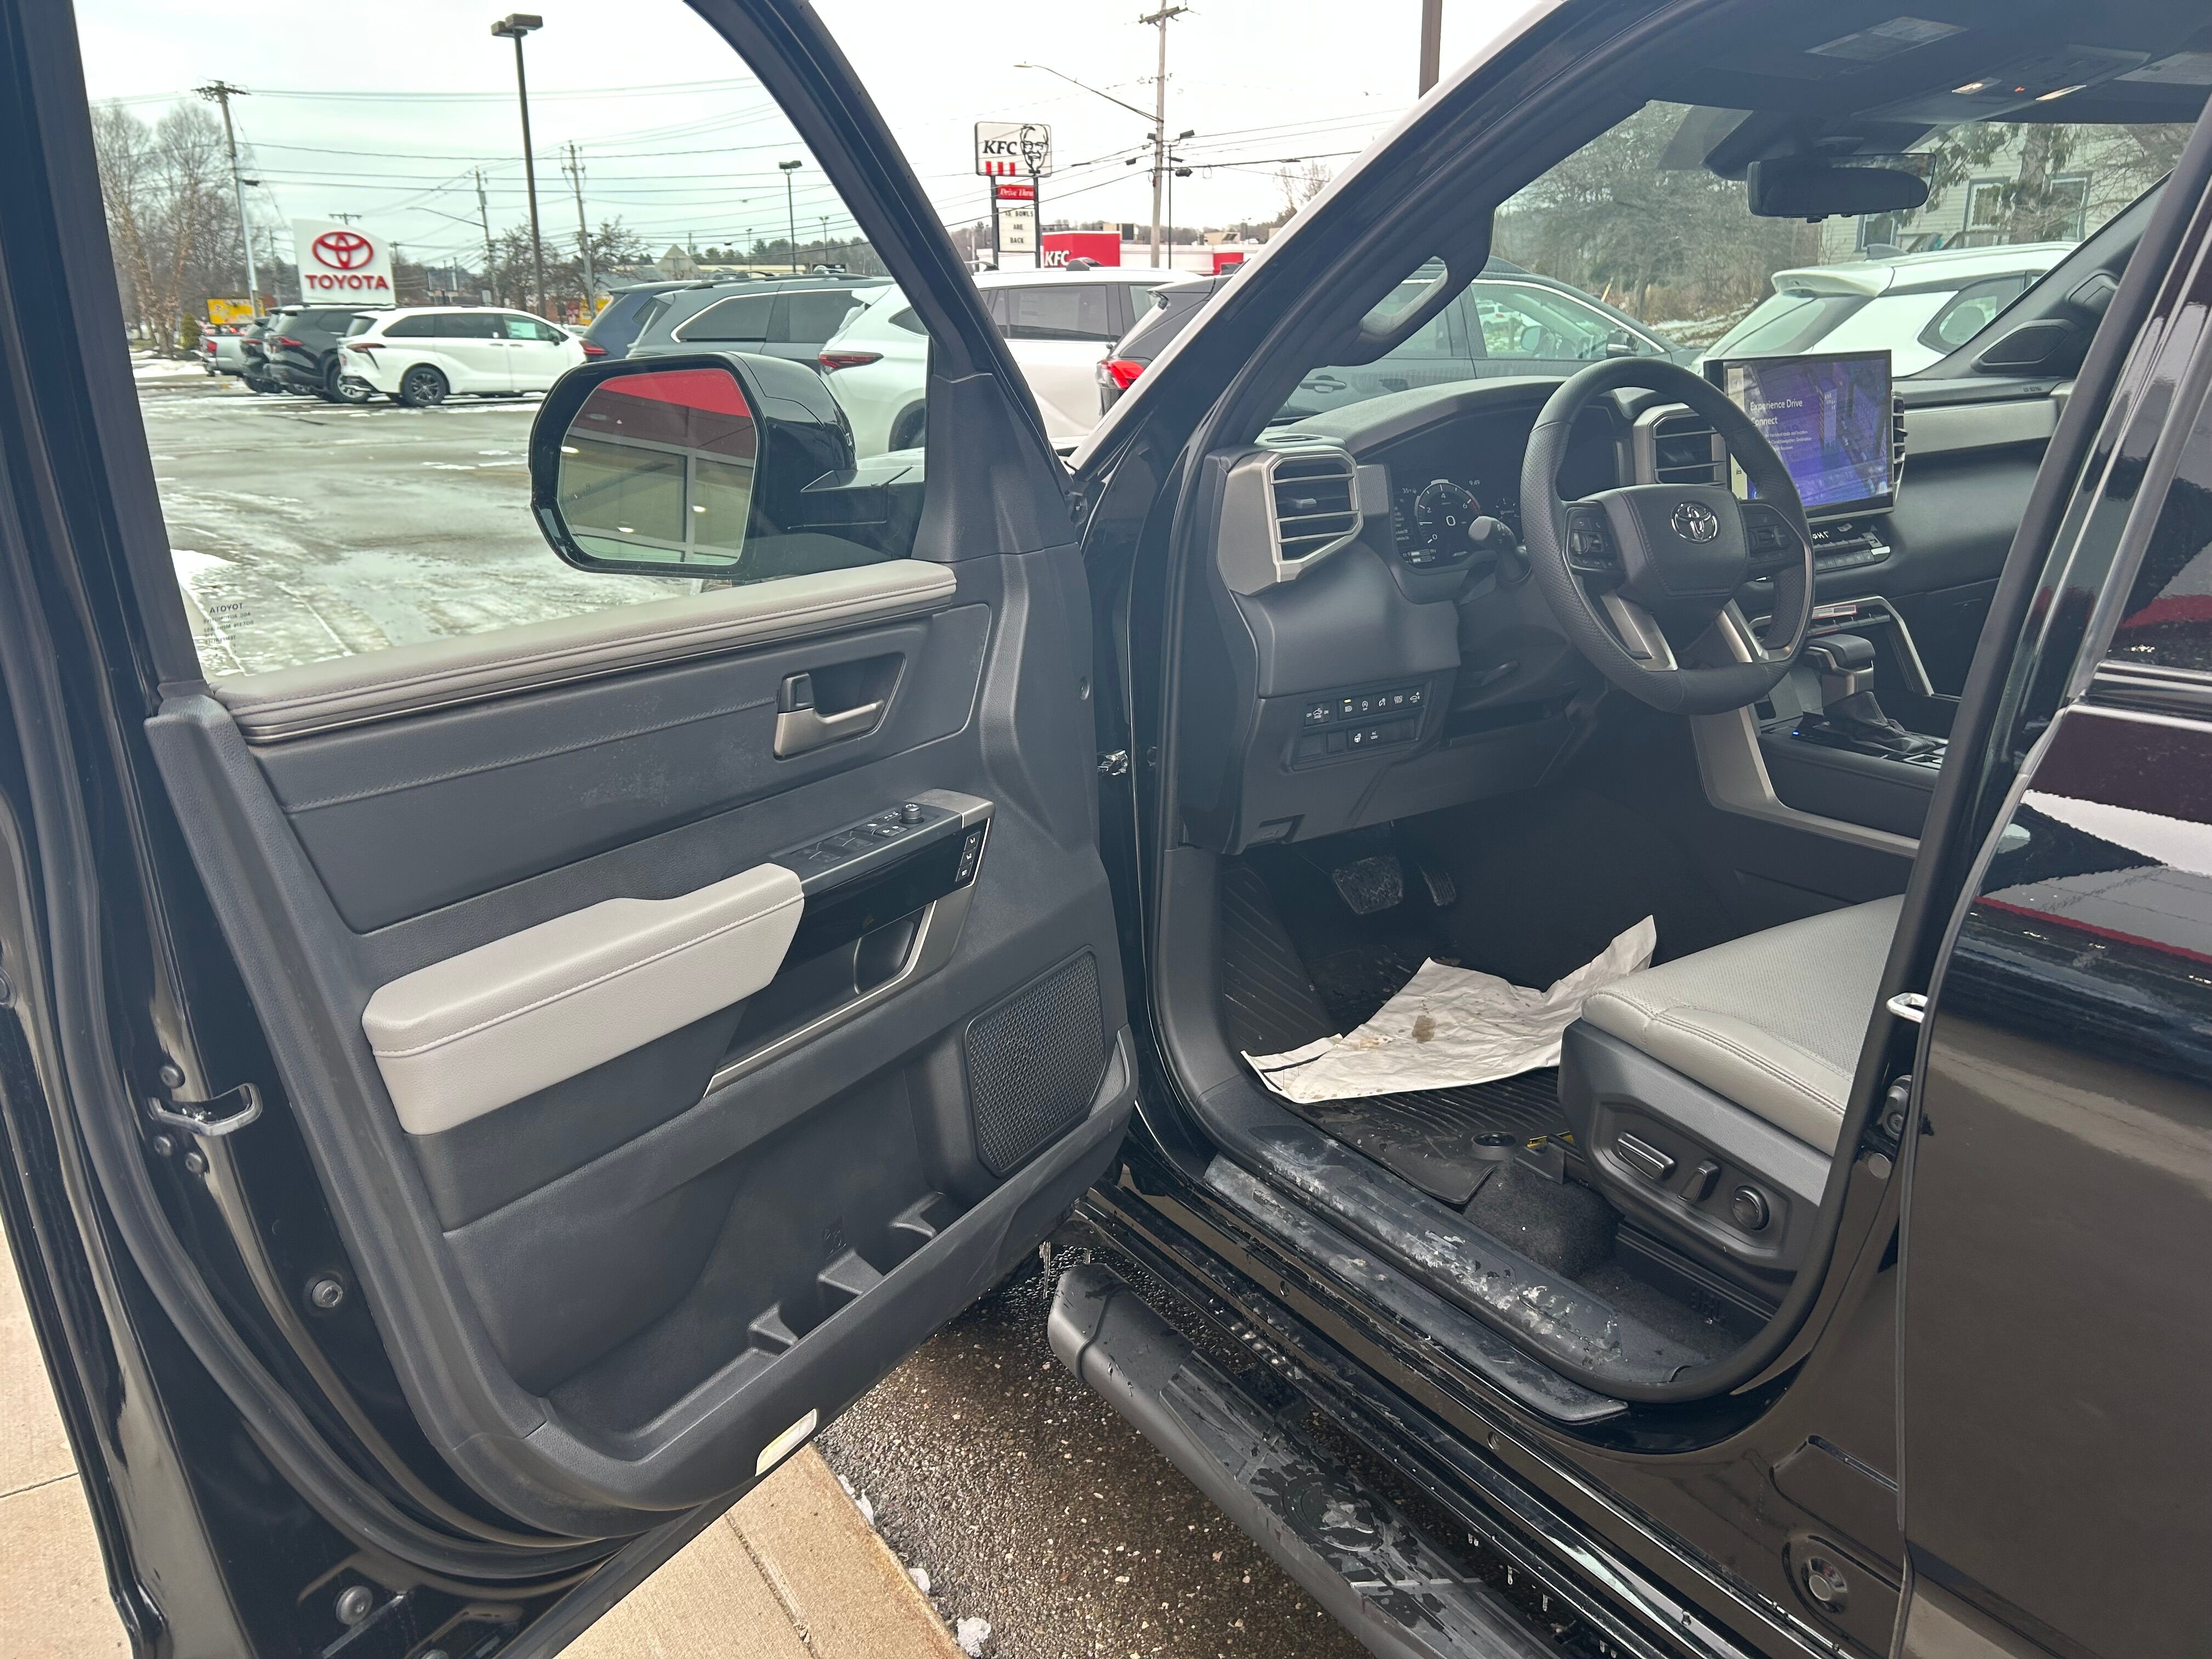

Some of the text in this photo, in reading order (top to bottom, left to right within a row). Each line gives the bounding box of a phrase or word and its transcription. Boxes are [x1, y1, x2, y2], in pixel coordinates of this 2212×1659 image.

[983, 140, 1018, 155] KFC
[1044, 250, 1070, 266] KFC
[305, 274, 389, 290] TOYOTA
[1750, 399, 1803, 413] Experience Drive
[1446, 515, 1455, 526] 0
